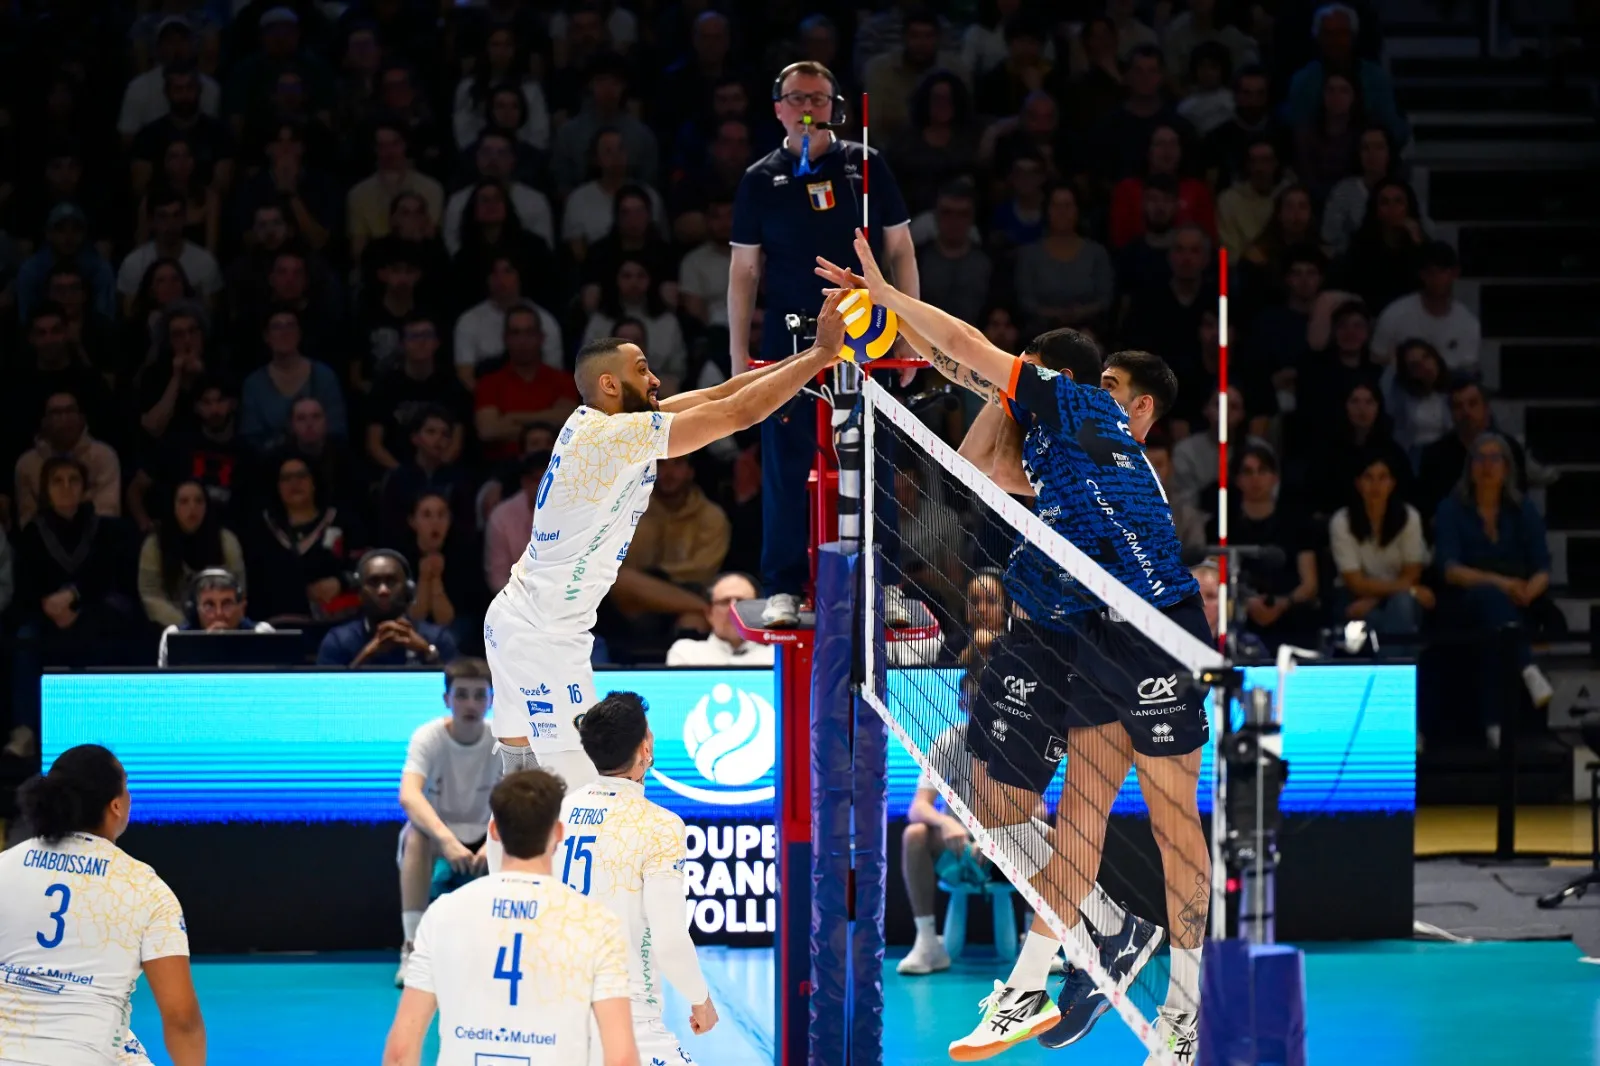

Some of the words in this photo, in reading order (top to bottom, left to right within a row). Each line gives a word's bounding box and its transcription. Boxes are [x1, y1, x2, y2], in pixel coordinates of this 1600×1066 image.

[572, 523, 609, 582] MARARA
[566, 683, 583, 704] 16
[1130, 704, 1187, 716] LANGUEDOC
[568, 807, 608, 825] PETRUS
[685, 825, 776, 859] OUPE
[23, 849, 110, 877] CHABOISSANT
[562, 835, 597, 896] 15
[683, 861, 776, 896] RAN
[36, 883, 71, 949] 3
[492, 898, 538, 919] HENNO
[493, 933, 522, 1005] 4
[640, 926, 654, 992] MARMAR
[47, 968, 94, 985] Mutuel
[455, 1026, 494, 1041] Crédit
[510, 1031, 556, 1046] Mutuel
